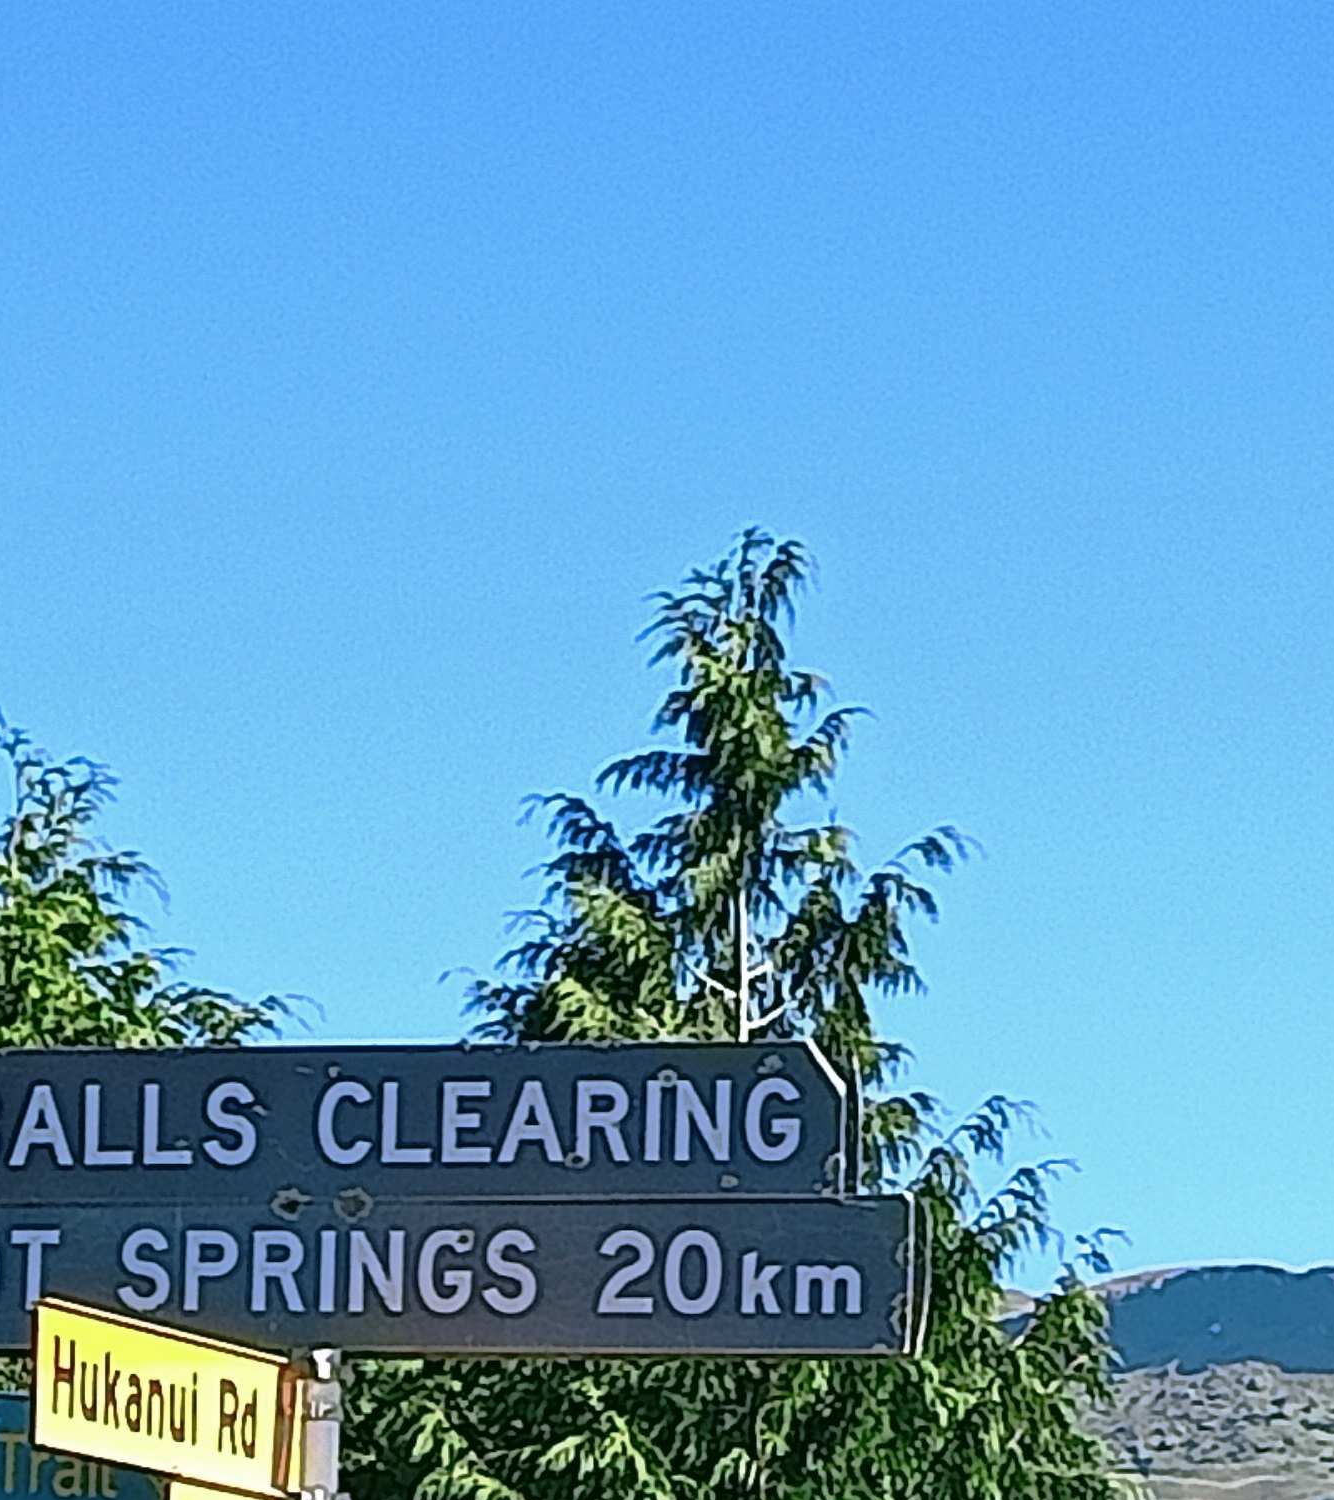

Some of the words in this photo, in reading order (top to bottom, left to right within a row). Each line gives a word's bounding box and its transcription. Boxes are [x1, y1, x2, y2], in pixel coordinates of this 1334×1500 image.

[317, 1077, 801, 1166] CLEARING
[117, 1229, 538, 1315] SPRINGS
[597, 1229, 862, 1315] 20km
[51, 1335, 198, 1447] Hukanui
[218, 1377, 258, 1460] Rd
